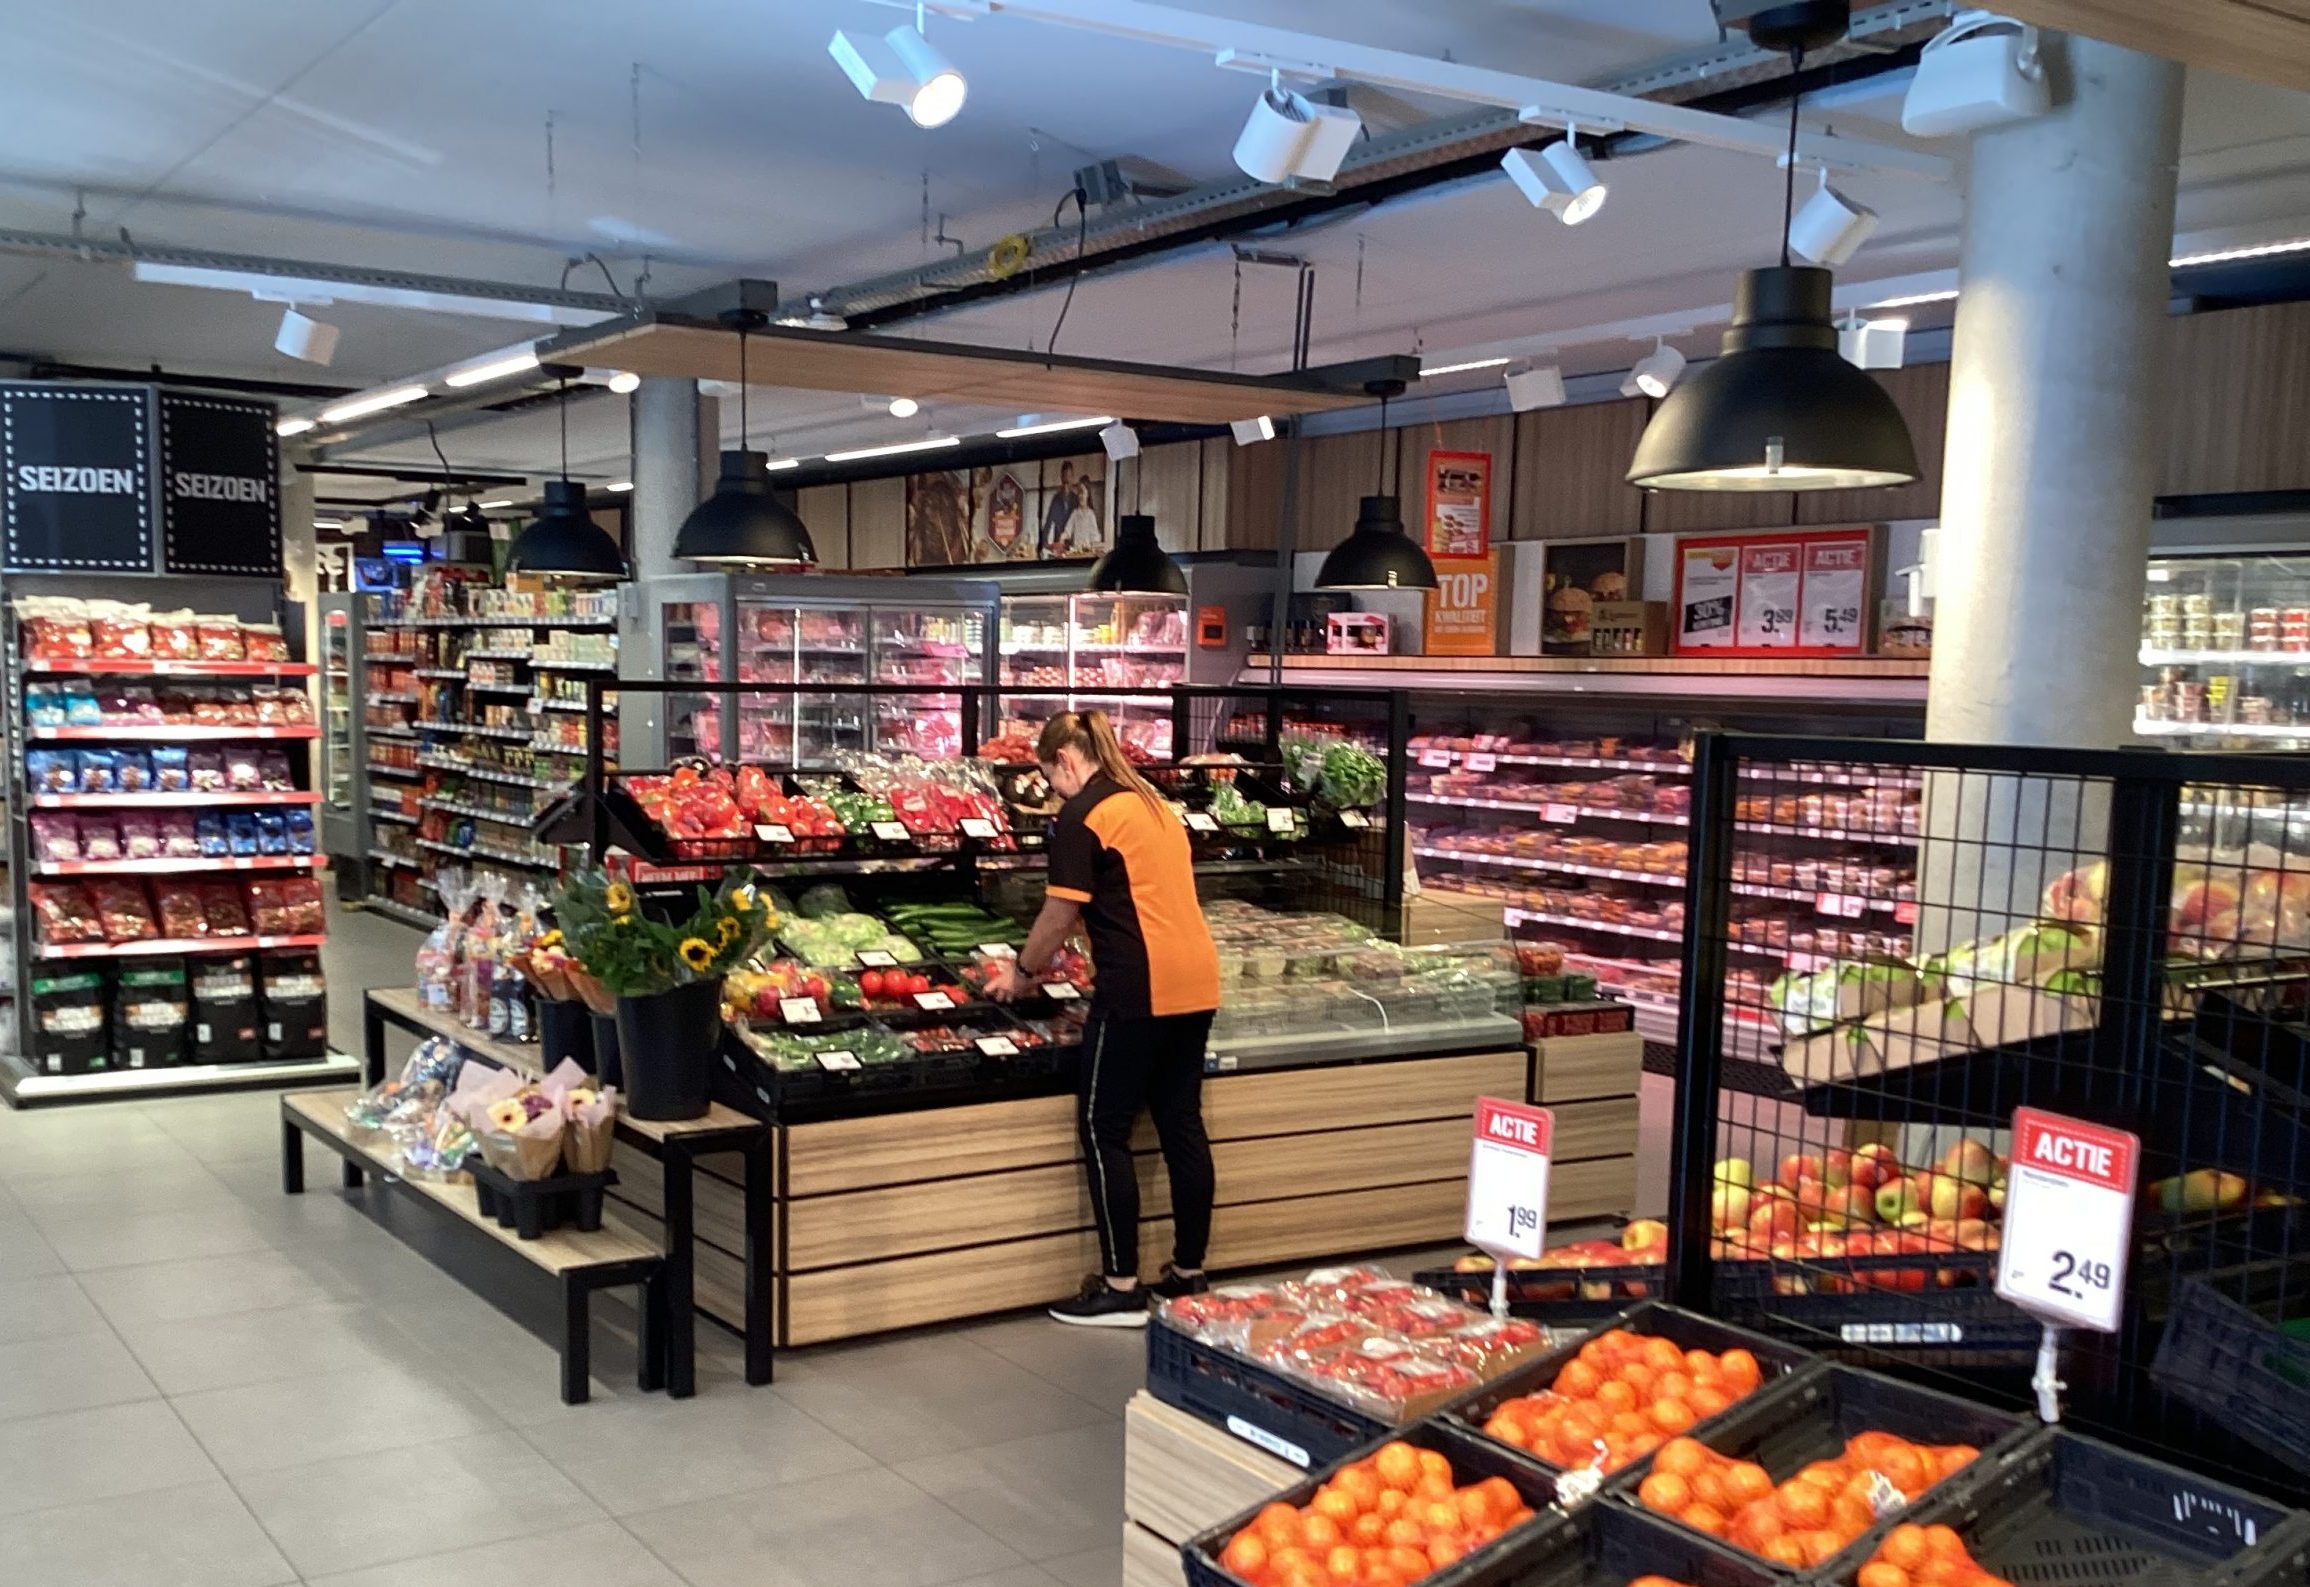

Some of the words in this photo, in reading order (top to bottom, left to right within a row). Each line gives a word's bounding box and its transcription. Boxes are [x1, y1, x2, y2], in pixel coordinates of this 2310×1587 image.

[18, 465, 134, 494] SEIZOEN
[174, 472, 267, 502] SEIZOEN
[1752, 552, 1791, 568] ACTIE
[1815, 550, 1856, 566] ACTIE
[1437, 573, 1488, 608] TOP
[1489, 1113, 1538, 1145] ACTIE
[2034, 1132, 2112, 1177] ACTIE
[2048, 1250, 2112, 1300] 2.49
